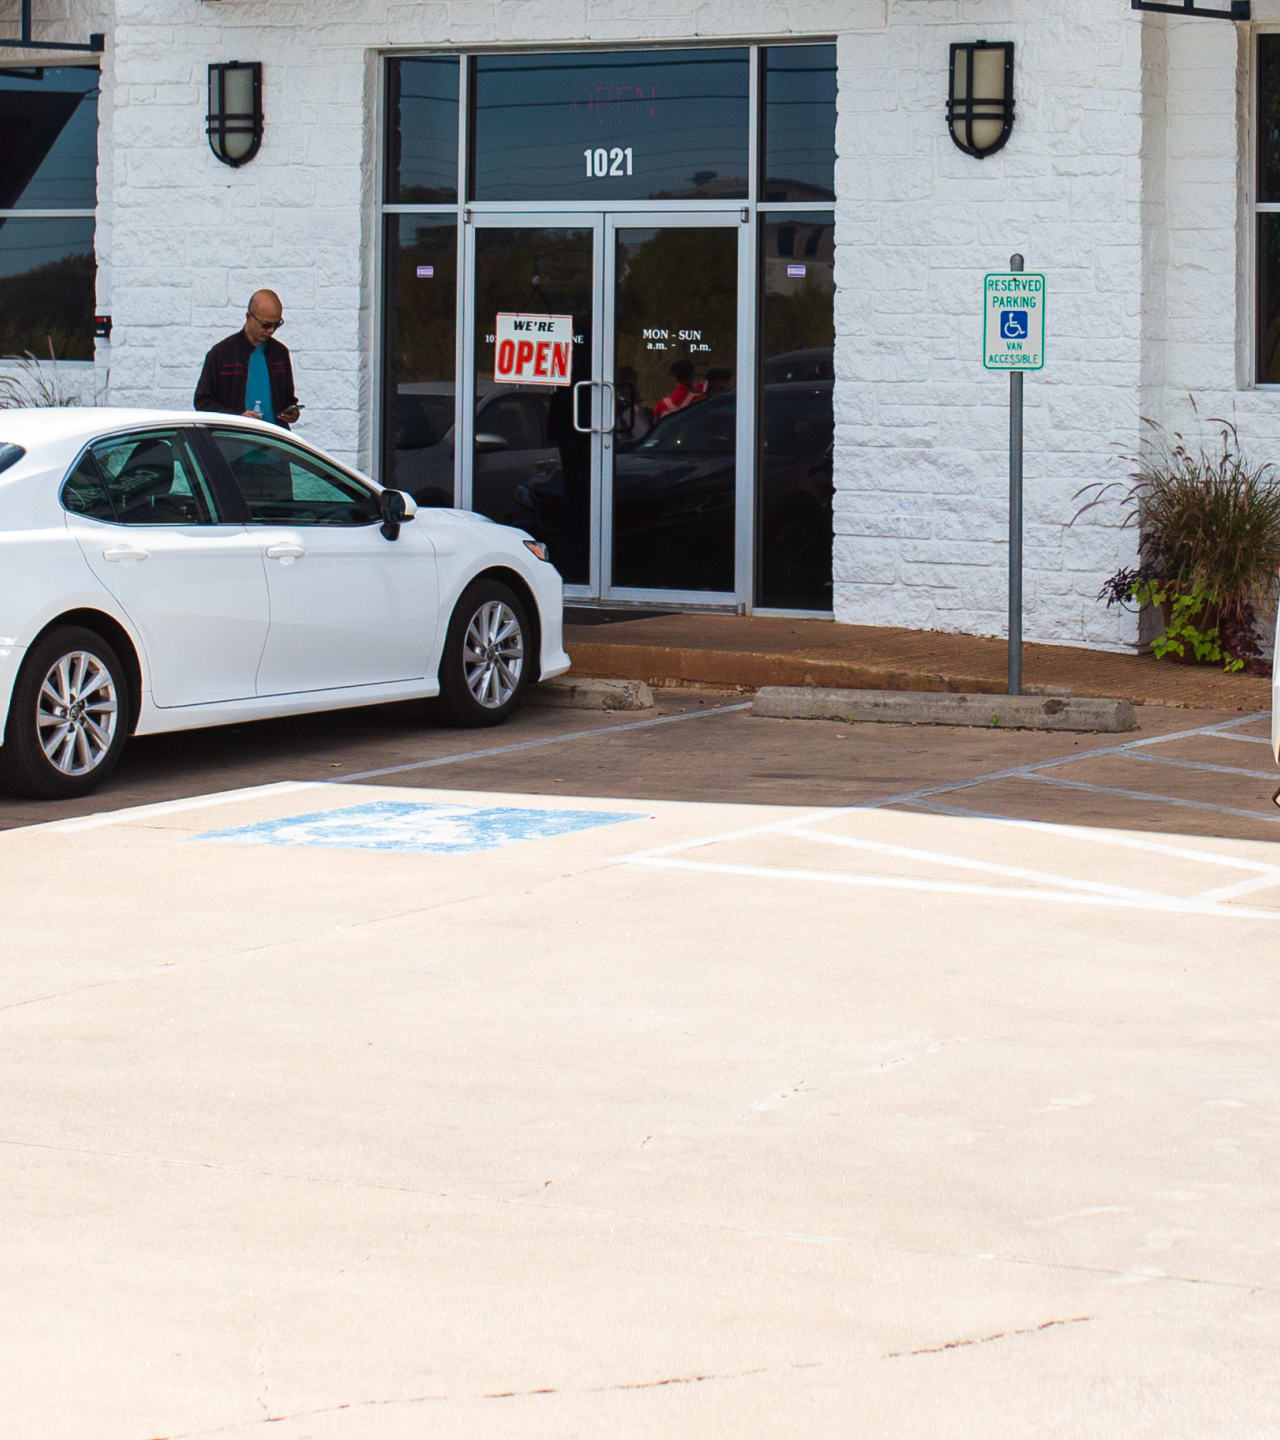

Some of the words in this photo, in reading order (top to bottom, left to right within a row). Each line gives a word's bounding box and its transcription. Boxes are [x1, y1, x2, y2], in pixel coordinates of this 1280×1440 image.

[584, 147, 633, 177] 1021
[987, 280, 1042, 292] RESERVED
[992, 296, 1037, 309] PARKING
[513, 320, 555, 333] WE'RE
[642, 329, 669, 340] MON
[678, 330, 702, 340] SUN
[646, 342, 668, 350] a.m.
[690, 343, 712, 353] p.m.
[1006, 342, 1023, 351] VAN
[497, 338, 570, 378] OPEN
[988, 354, 1039, 365] ACCESSIBLE
